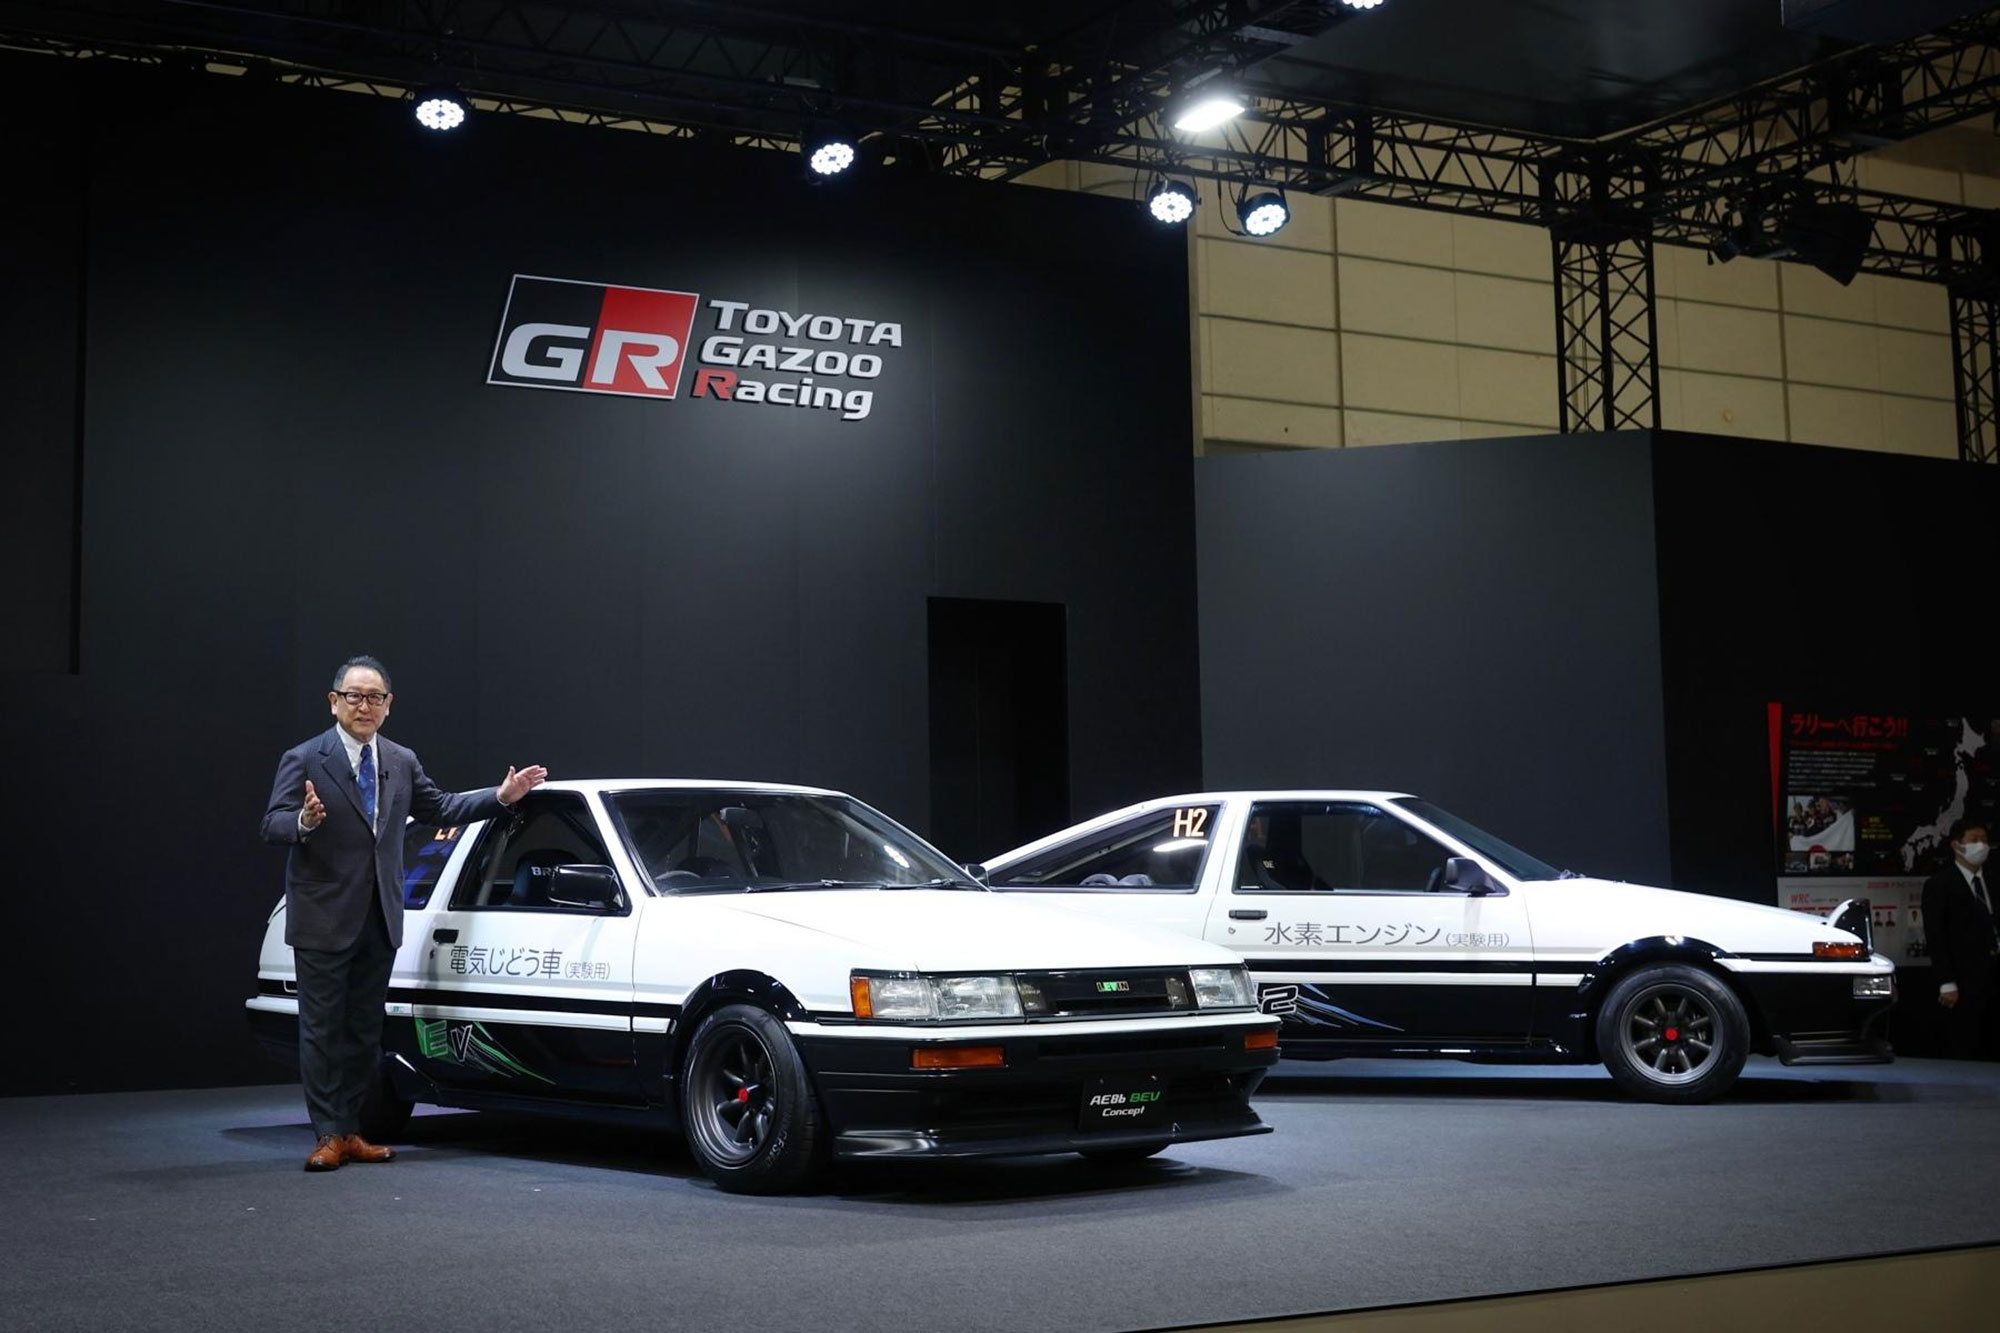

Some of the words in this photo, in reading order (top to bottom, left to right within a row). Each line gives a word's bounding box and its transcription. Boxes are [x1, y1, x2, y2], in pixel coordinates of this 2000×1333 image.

[709, 300, 903, 347] TOYOTA
[502, 323, 679, 390] GR
[701, 335, 882, 378] GAZOO
[694, 369, 874, 420] Racing
[1173, 808, 1208, 837] H2
[422, 1018, 473, 1063] EV
[1102, 1105, 1145, 1117] Concept
[1129, 1091, 1161, 1103] BEV
